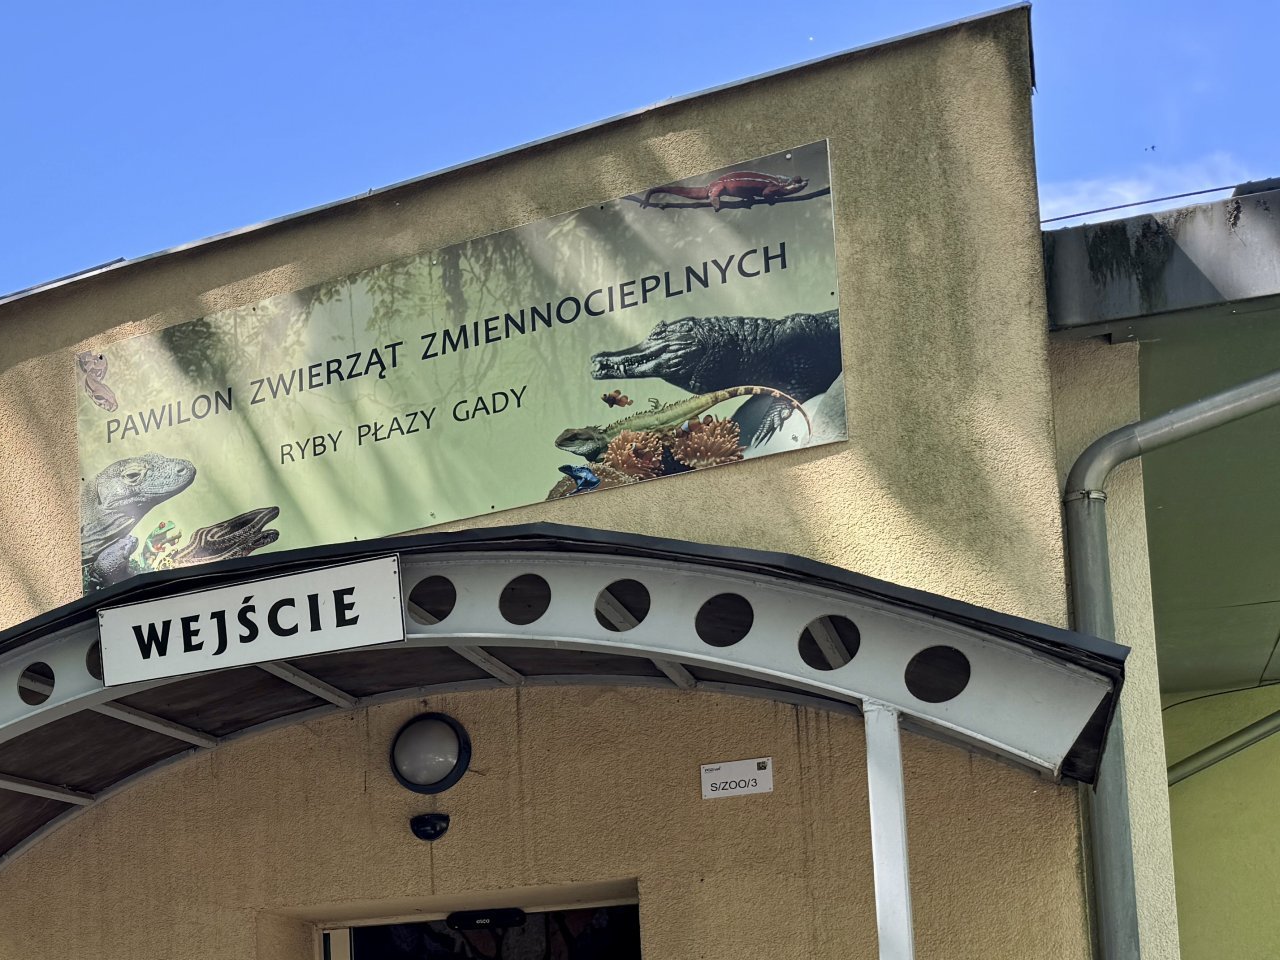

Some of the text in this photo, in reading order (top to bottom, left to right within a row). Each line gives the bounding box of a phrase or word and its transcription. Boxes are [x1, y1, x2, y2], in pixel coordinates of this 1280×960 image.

[105, 241, 788, 444] PAWILON ZWIERZĄT ZMIENNOCIEPLNYCH
[280, 385, 528, 465] RYBY PŁAZY GADY
[131, 586, 360, 660] WEJŚCIE
[710, 778, 758, 792] S/ZOO/3
